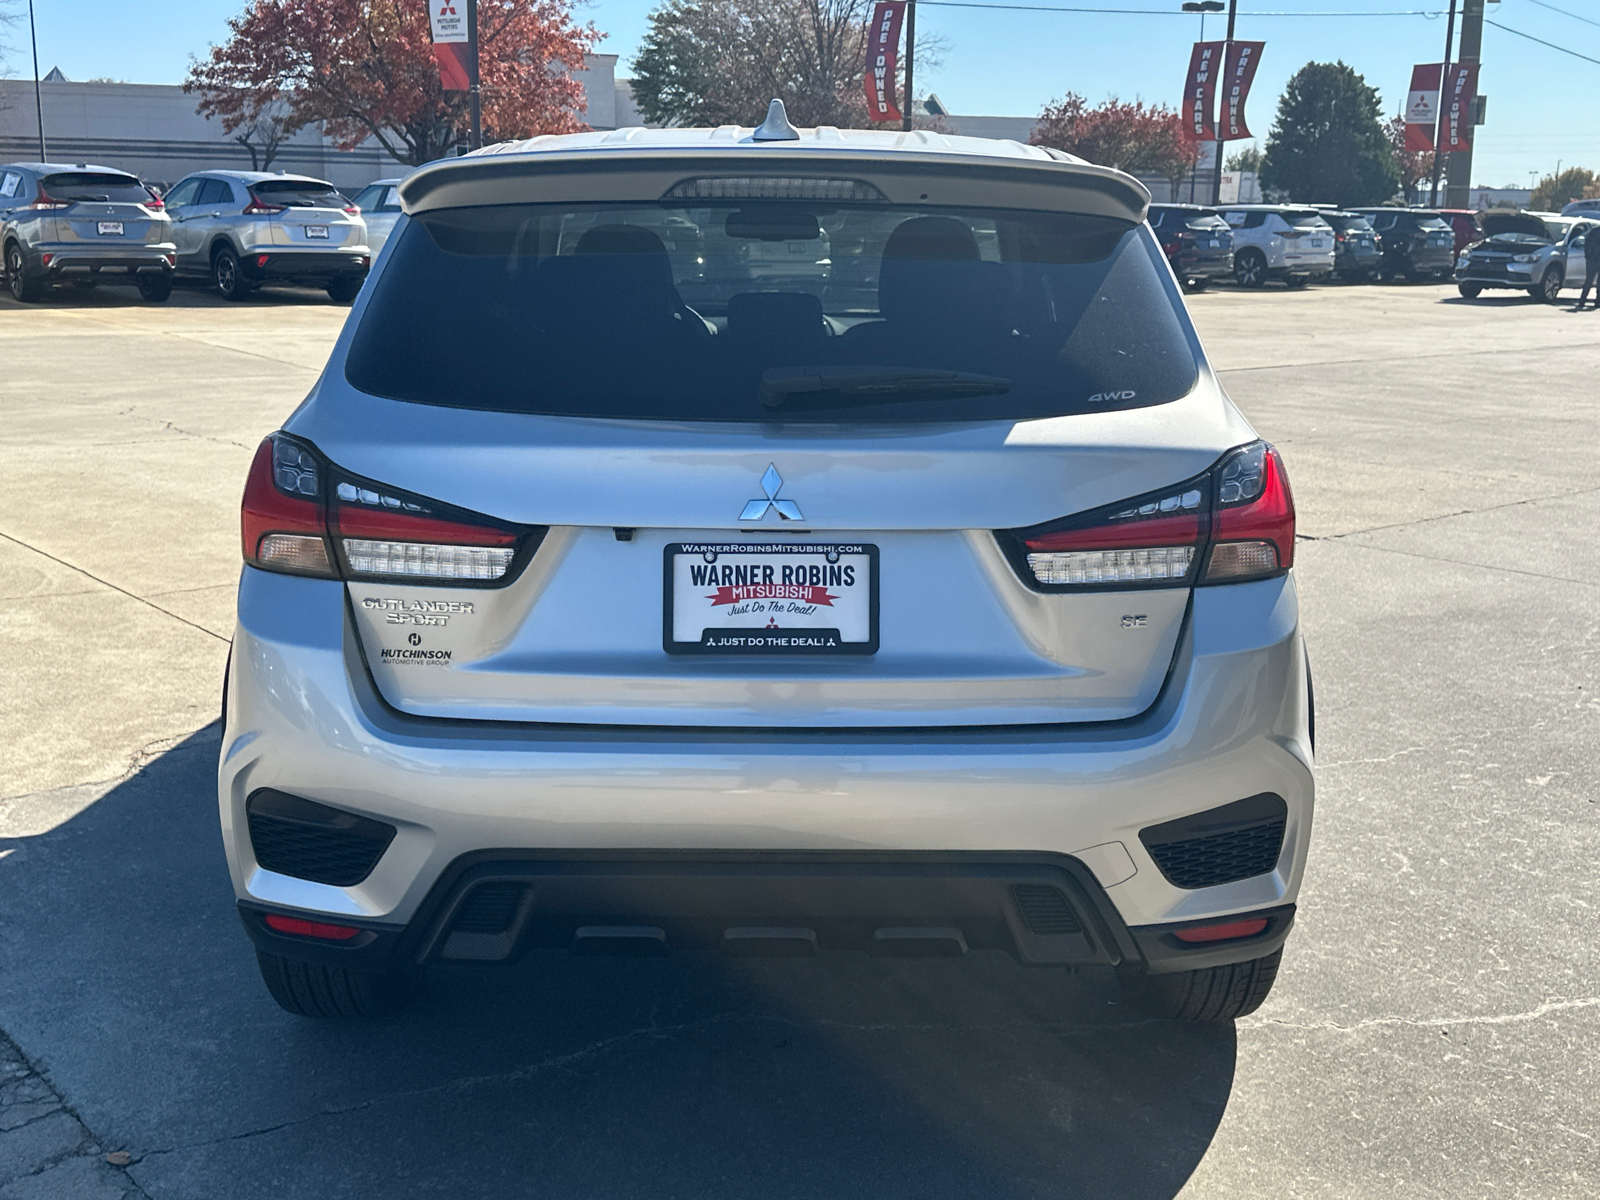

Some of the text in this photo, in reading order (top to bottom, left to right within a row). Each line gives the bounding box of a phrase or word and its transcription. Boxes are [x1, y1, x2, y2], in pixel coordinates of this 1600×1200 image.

[874, 9, 894, 113] PRE-OWNED
[1194, 49, 1212, 135] NEW CARS
[1229, 47, 1252, 135] PRE-OWNED
[1449, 69, 1469, 145] PRE-OWNED
[1088, 390, 1136, 402] 4WD
[690, 564, 856, 587] WARNER ROBINS
[732, 585, 813, 600] MITSUBISHI
[361, 597, 475, 614] OUTLANDER
[727, 601, 818, 616] Just Do The Deal!
[386, 612, 450, 626] SPORT
[1120, 614, 1147, 630] SE
[717, 637, 824, 646] JUST DO THE DEAL!
[381, 648, 453, 660] HUTCHINSON
[382, 658, 424, 666] AUTOMOTIVE
